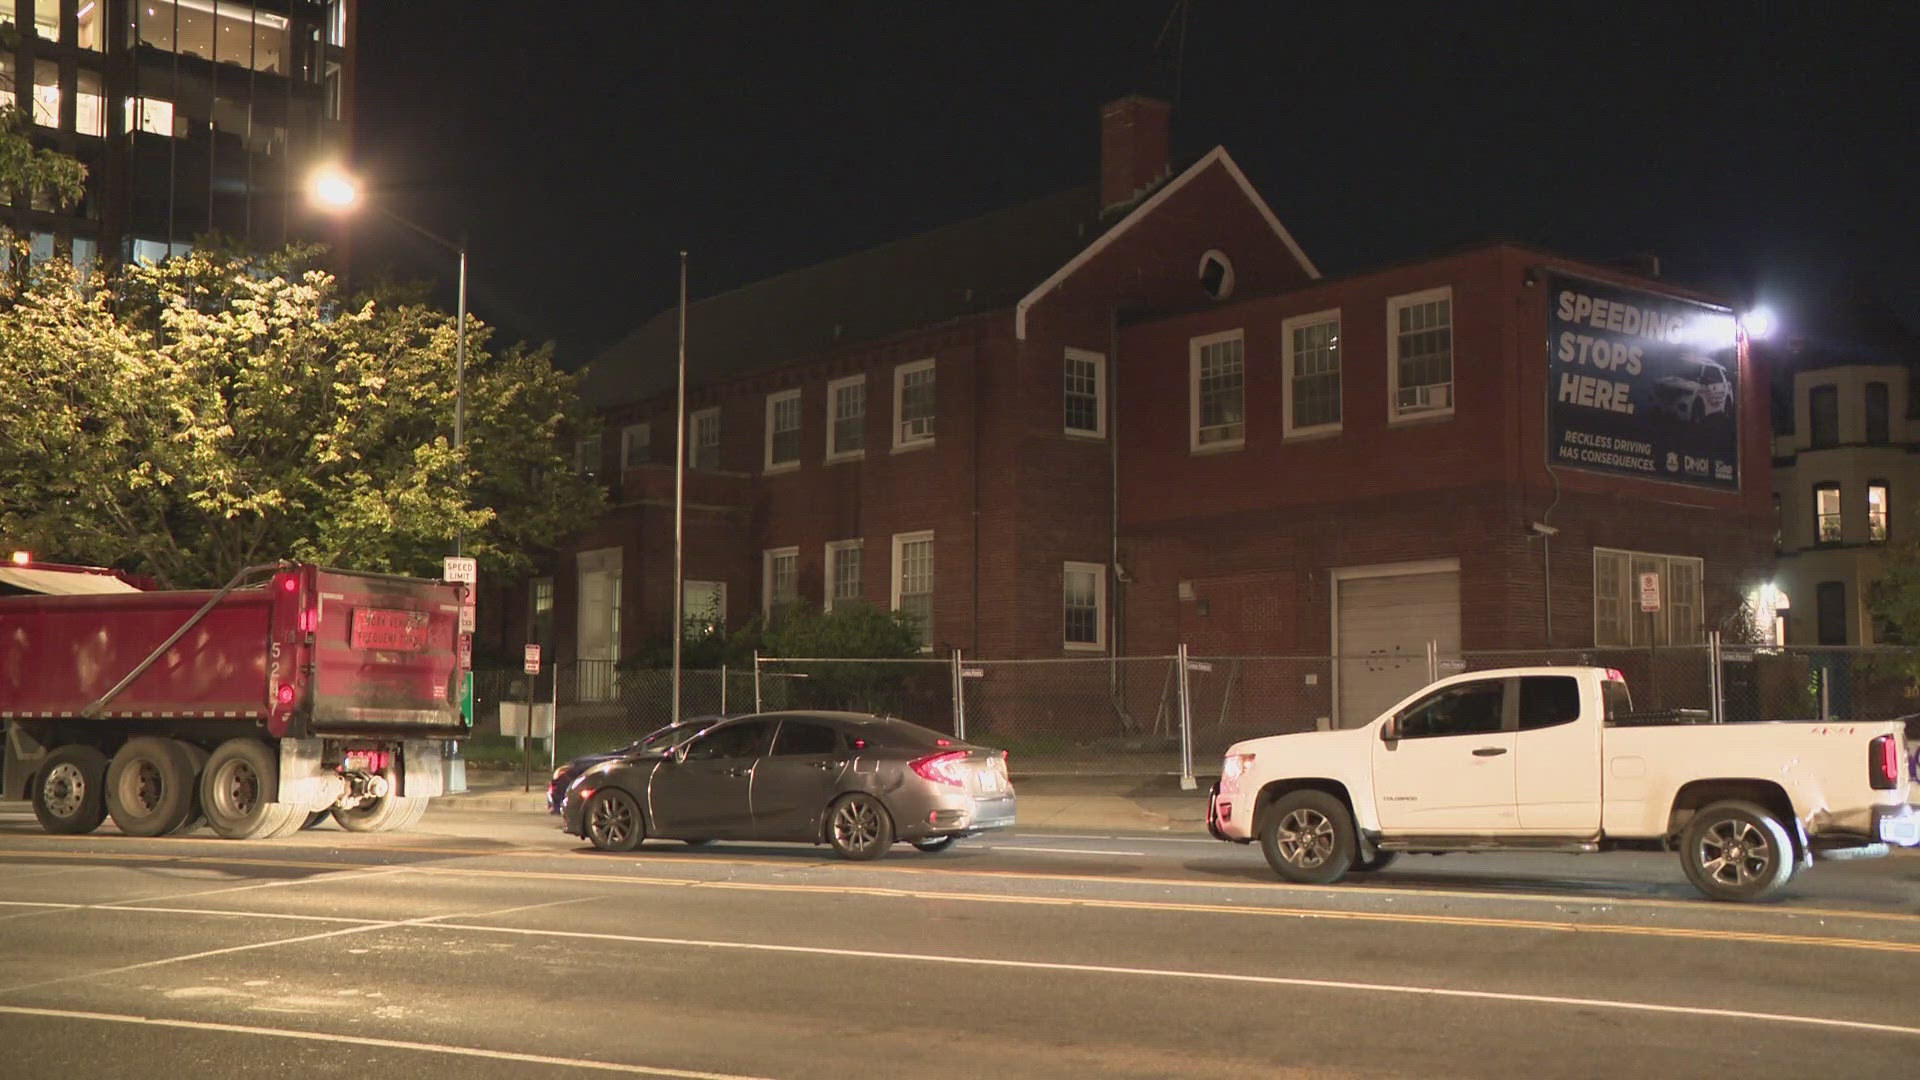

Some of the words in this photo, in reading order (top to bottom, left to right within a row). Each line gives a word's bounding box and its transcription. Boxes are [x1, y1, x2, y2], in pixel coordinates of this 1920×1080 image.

[1557, 290, 1683, 344] SPEEDING
[1558, 331, 1643, 376] STOPS
[1558, 372, 1634, 415] HERE.
[1564, 430, 1612, 449] RECKLESS
[1613, 438, 1652, 455] DRIVING
[1559, 446, 1579, 460] HAS
[1581, 449, 1656, 471] CONSEQUENCES.
[447, 562, 473, 572] SPEED
[449, 572, 470, 580] LIMIT
